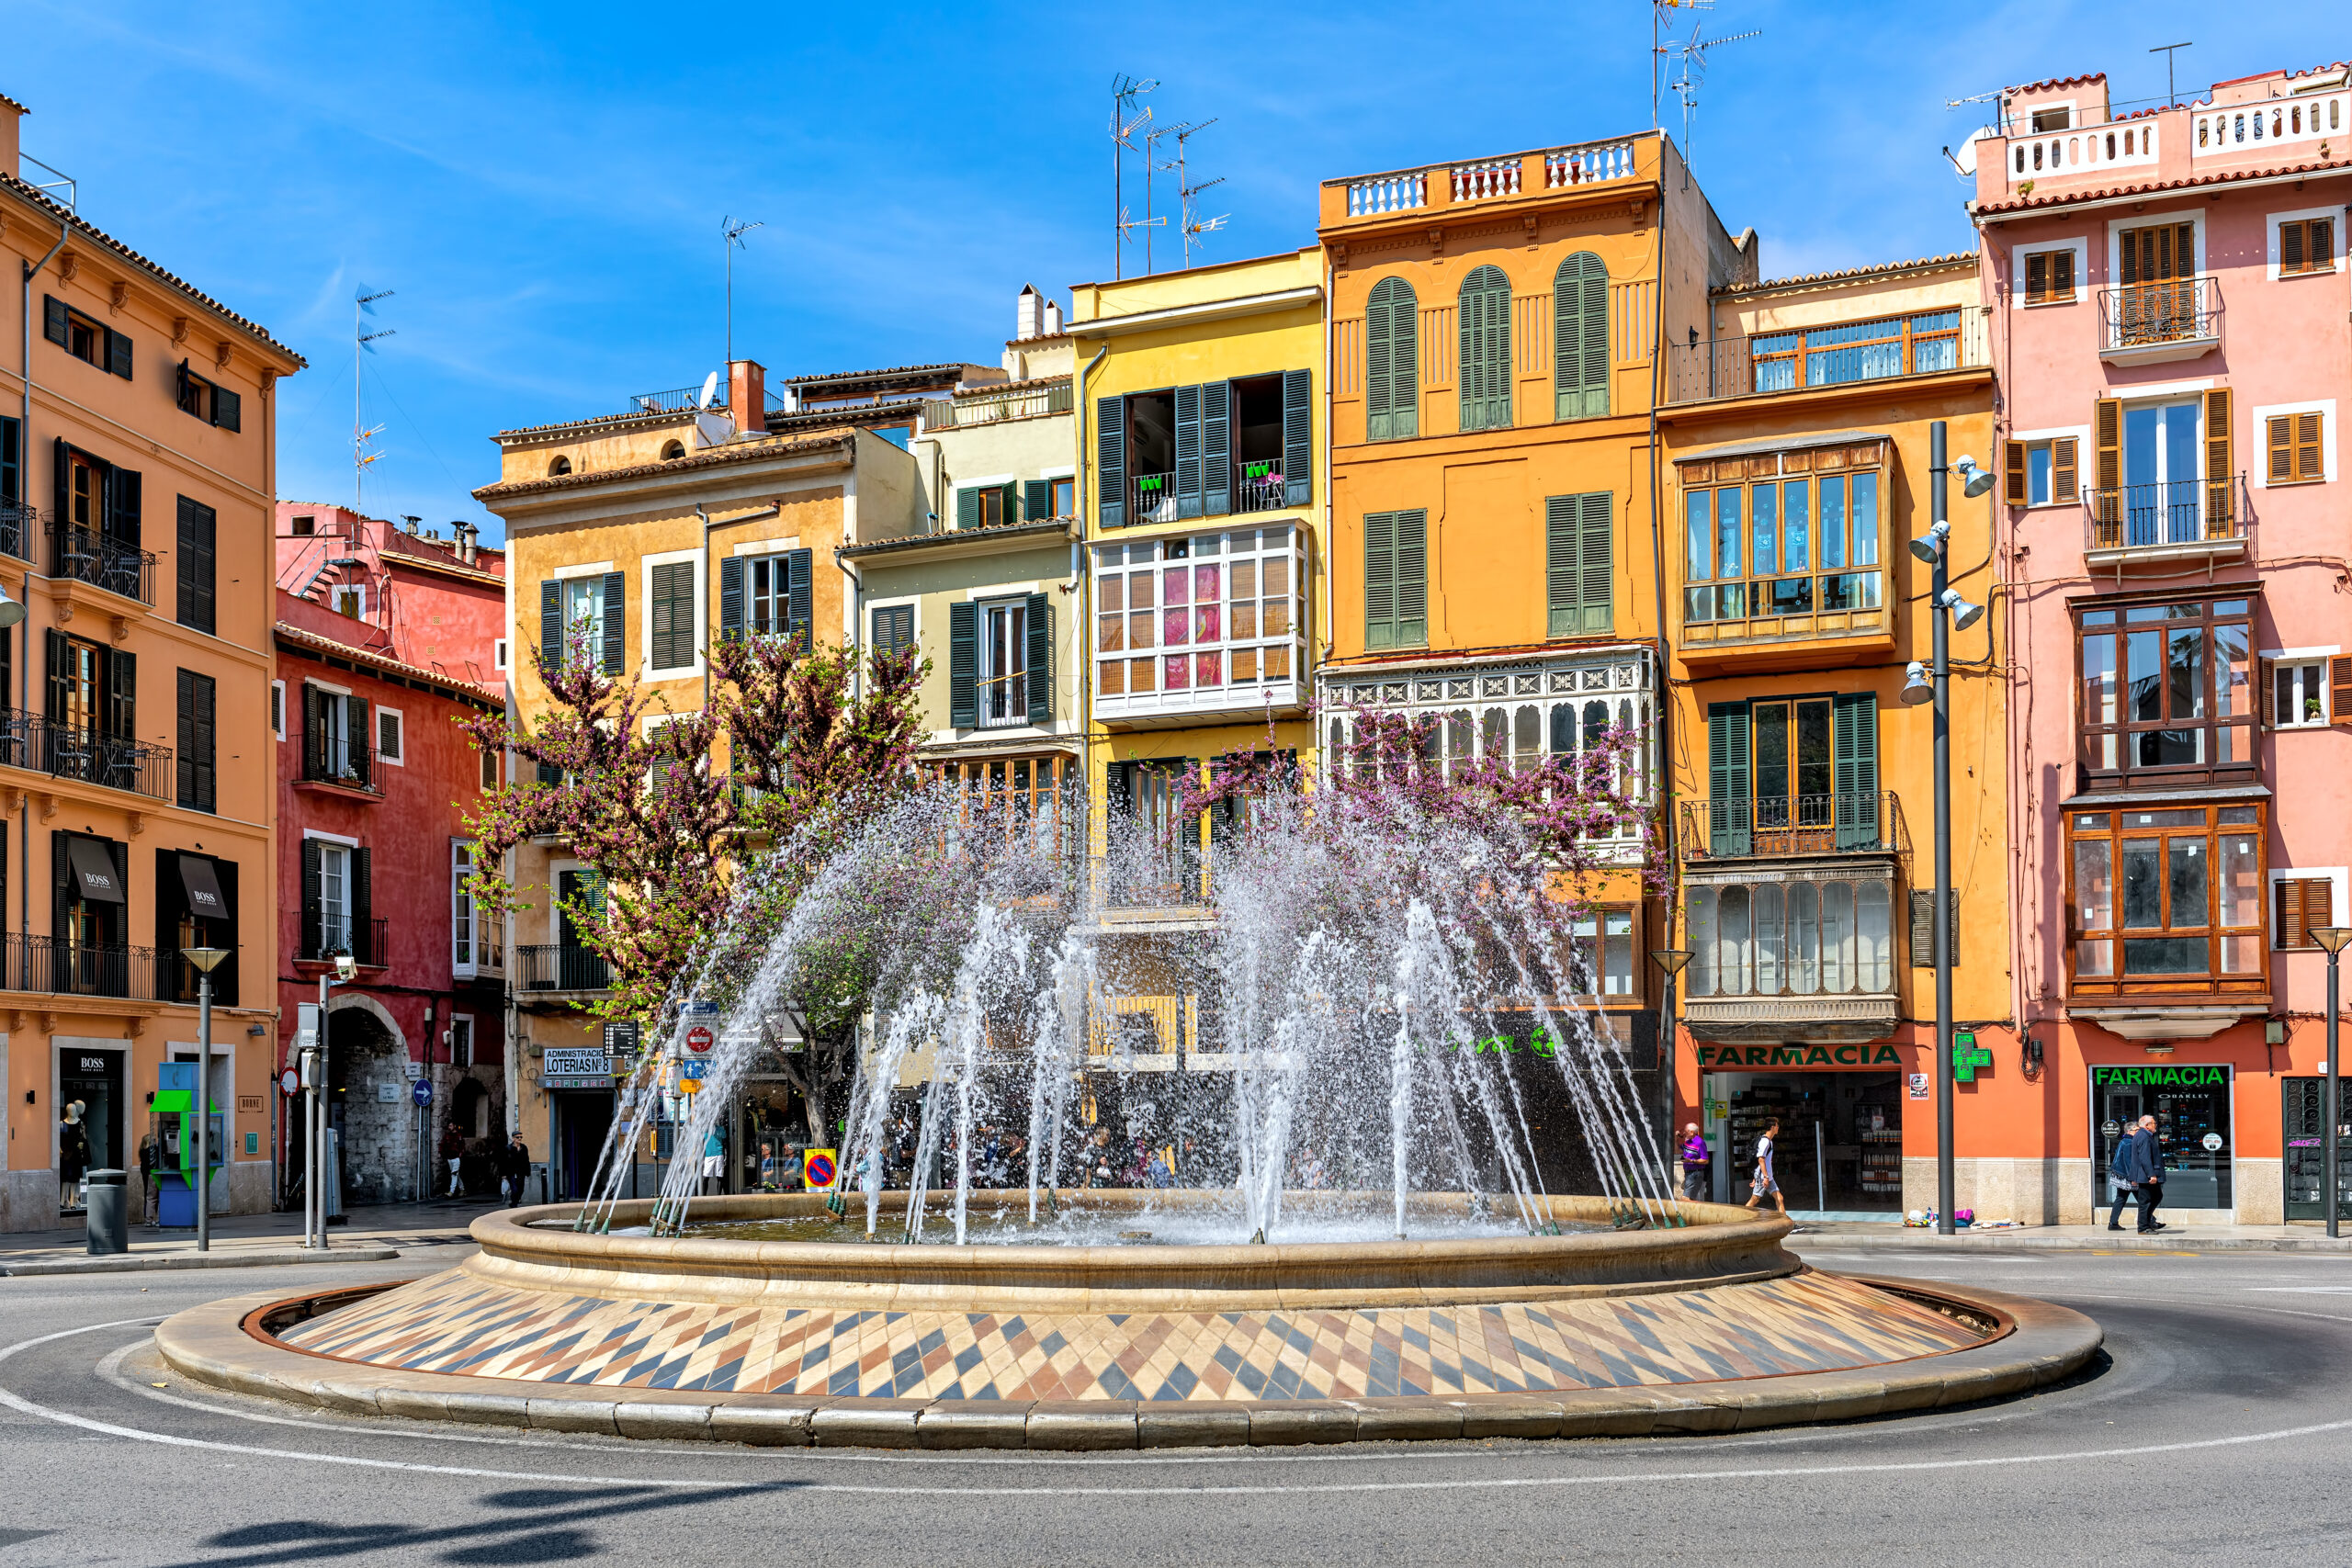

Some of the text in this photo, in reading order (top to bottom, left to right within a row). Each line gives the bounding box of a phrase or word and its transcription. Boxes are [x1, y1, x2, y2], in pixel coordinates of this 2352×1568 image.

[85, 873, 109, 886] BOSS
[194, 890, 216, 903] BOSS
[1698, 1045, 1903, 1066] FARMACIA
[81, 1057, 104, 1068] BOSS
[547, 1059, 591, 1072] LOTERIAS
[603, 1058, 609, 1072] 8
[2097, 1067, 2223, 1085] FARMACIA
[243, 1099, 259, 1108] BORNE
